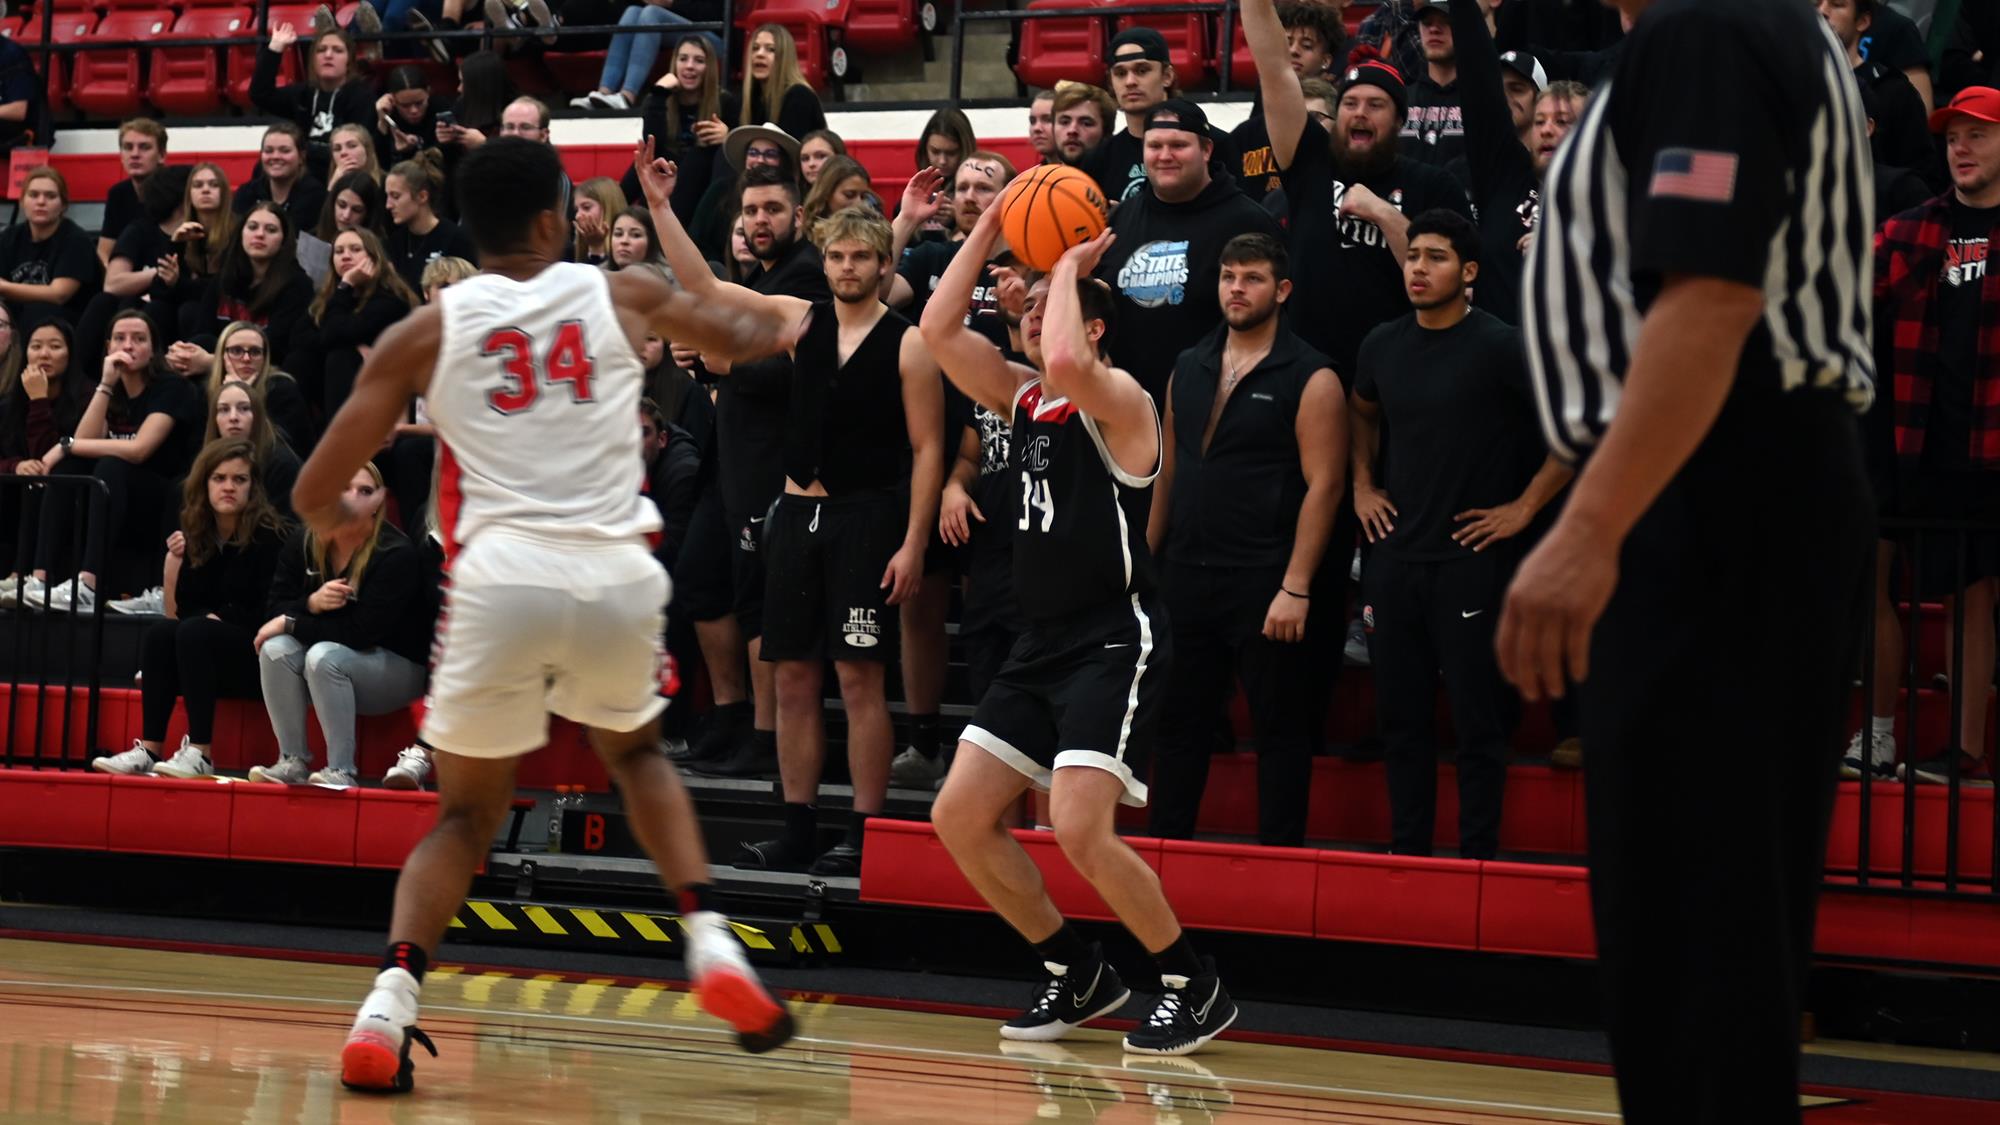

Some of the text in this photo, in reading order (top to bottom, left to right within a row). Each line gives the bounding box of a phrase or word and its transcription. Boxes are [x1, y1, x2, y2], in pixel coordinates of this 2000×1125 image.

[1131, 252, 1187, 274] STATE
[1117, 267, 1189, 288] CHAMPIONS
[478, 319, 598, 416] 34
[1018, 471, 1055, 533] 34
[848, 607, 877, 624] MLC
[842, 623, 881, 635] ATHLETICS
[585, 814, 606, 851] B
